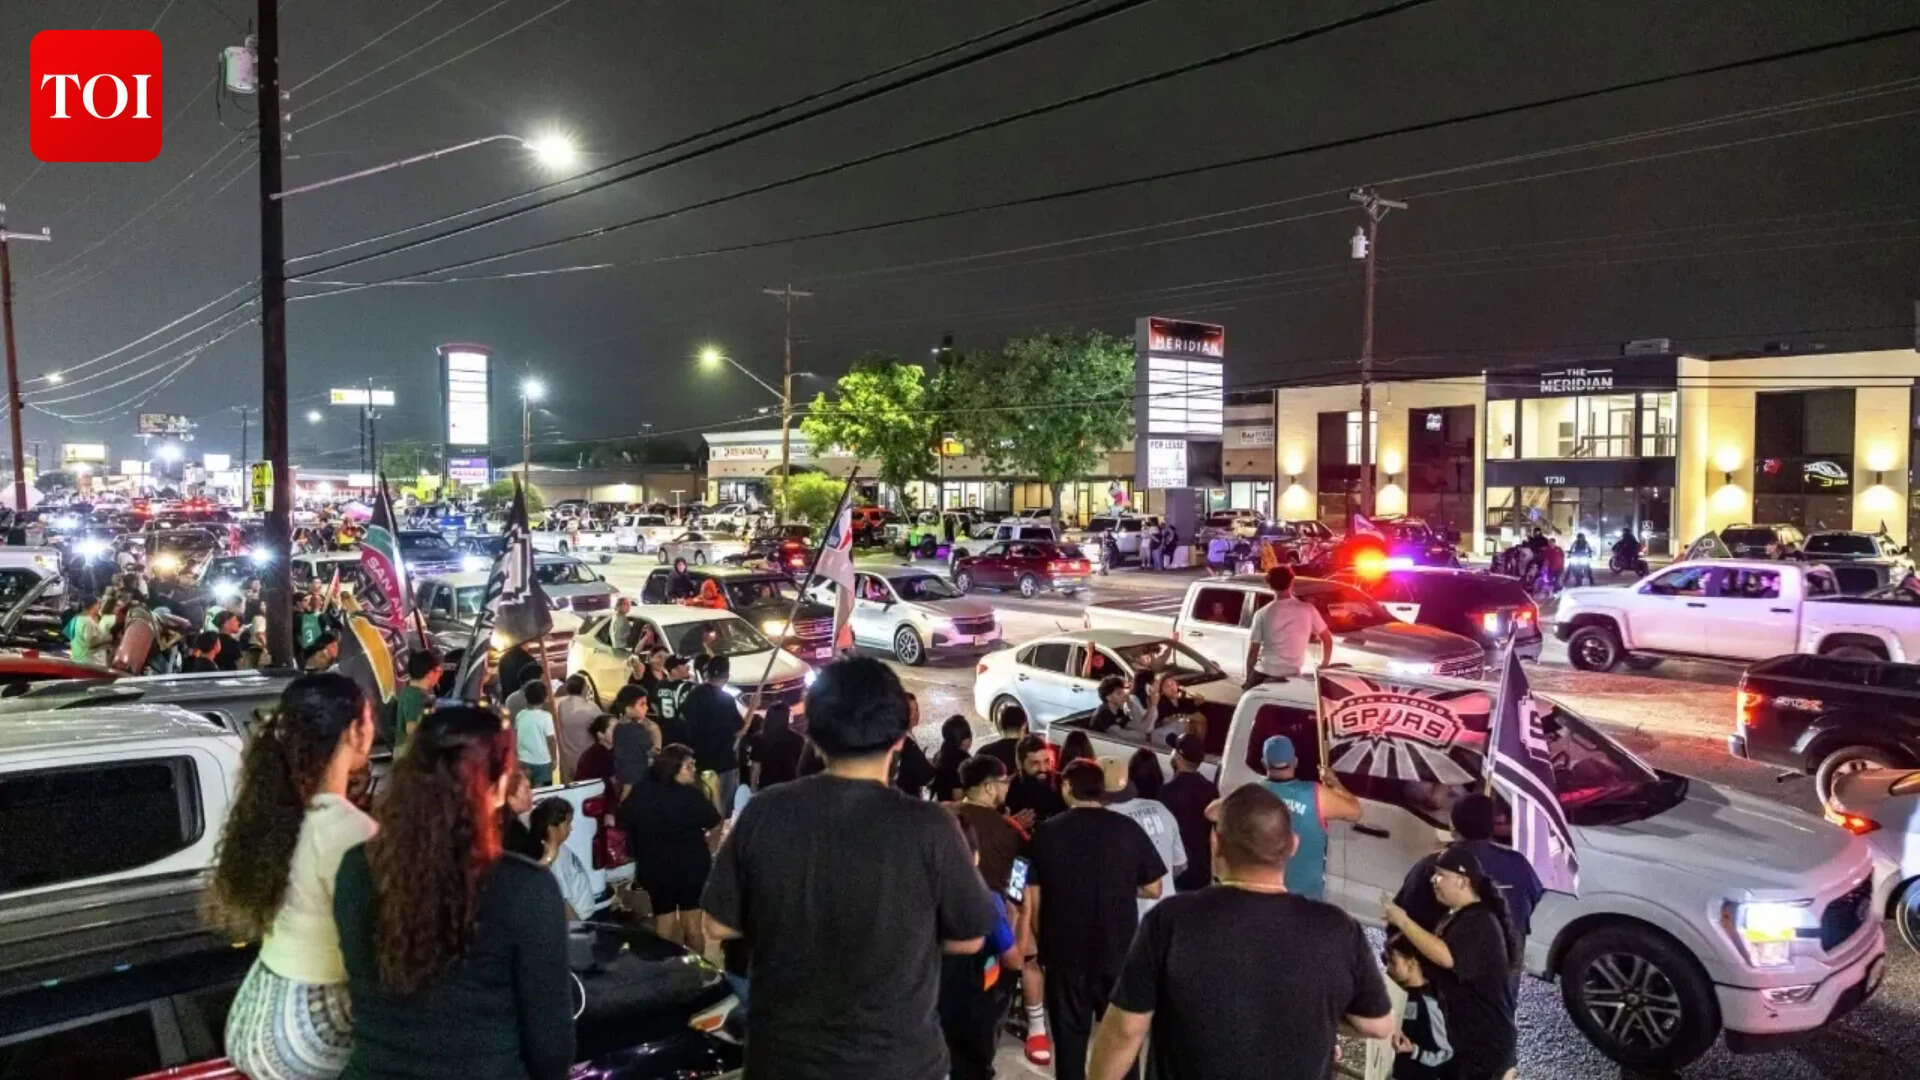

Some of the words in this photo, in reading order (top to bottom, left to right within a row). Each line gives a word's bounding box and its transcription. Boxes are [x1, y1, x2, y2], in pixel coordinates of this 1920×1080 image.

[1154, 335, 1219, 354] MERIDIAN
[1566, 368, 1587, 377] THE
[1540, 377, 1614, 393] MERIDIAN
[1544, 475, 1566, 485] 1730
[367, 556, 394, 591] SAN
[661, 698, 675, 718] 5
[1341, 707, 1446, 739] SPURS
